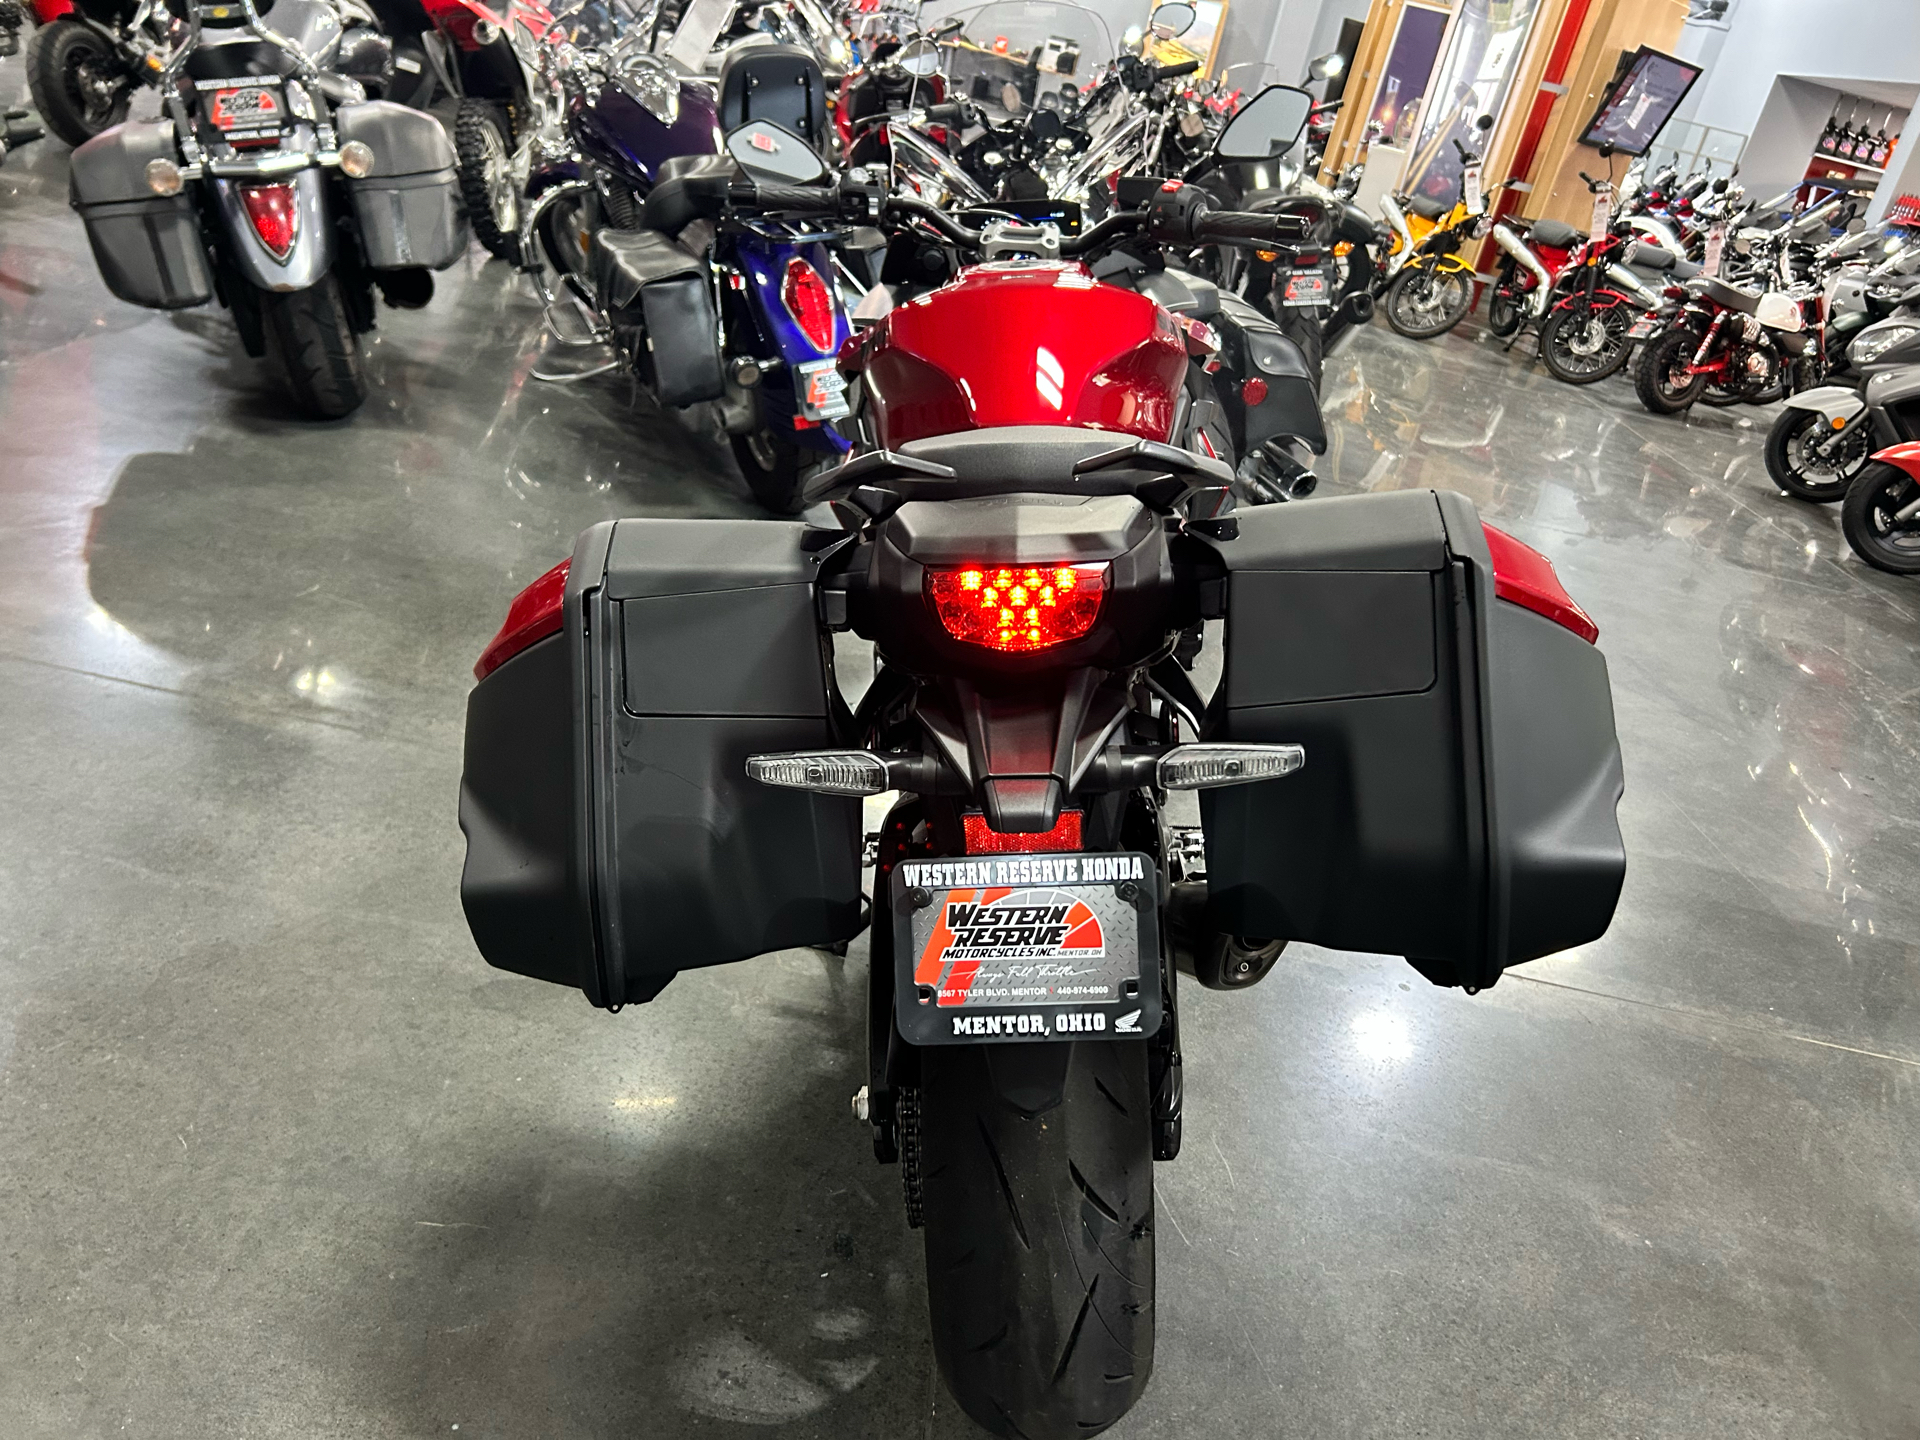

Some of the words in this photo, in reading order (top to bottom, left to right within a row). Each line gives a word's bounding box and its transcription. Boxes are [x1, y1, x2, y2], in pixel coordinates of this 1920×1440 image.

[903, 862, 992, 887] WESTERN
[996, 860, 1078, 884] RESERVE
[1082, 857, 1144, 881] HONDA
[948, 904, 1069, 927] WESTERN
[954, 926, 1069, 947] RESERVE
[942, 947, 1034, 960] MOTORCYCLES
[1035, 947, 1056, 957] INC.
[958, 988, 984, 997] TYLER
[986, 988, 1010, 997] BLVD.
[1012, 987, 1047, 996] MENTOR
[1057, 986, 1109, 995] 440-974-6900
[952, 1014, 1051, 1037] MENTOR,
[1055, 1012, 1106, 1033] OHIO
